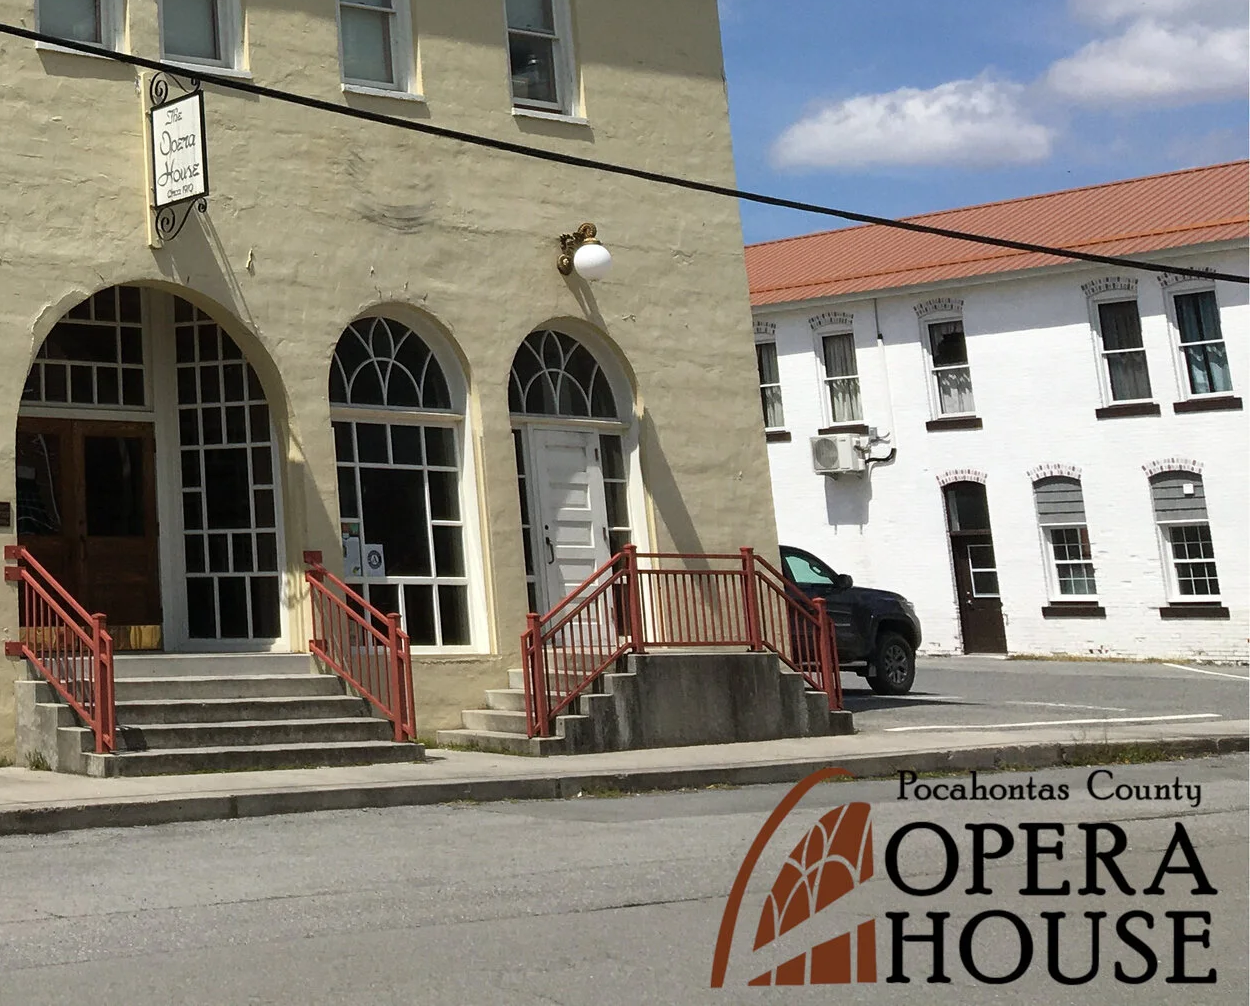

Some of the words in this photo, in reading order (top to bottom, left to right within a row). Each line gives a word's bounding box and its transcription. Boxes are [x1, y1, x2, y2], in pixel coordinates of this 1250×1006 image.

[165, 107, 182, 125] The
[160, 130, 196, 156] Opera
[157, 158, 200, 187] House
